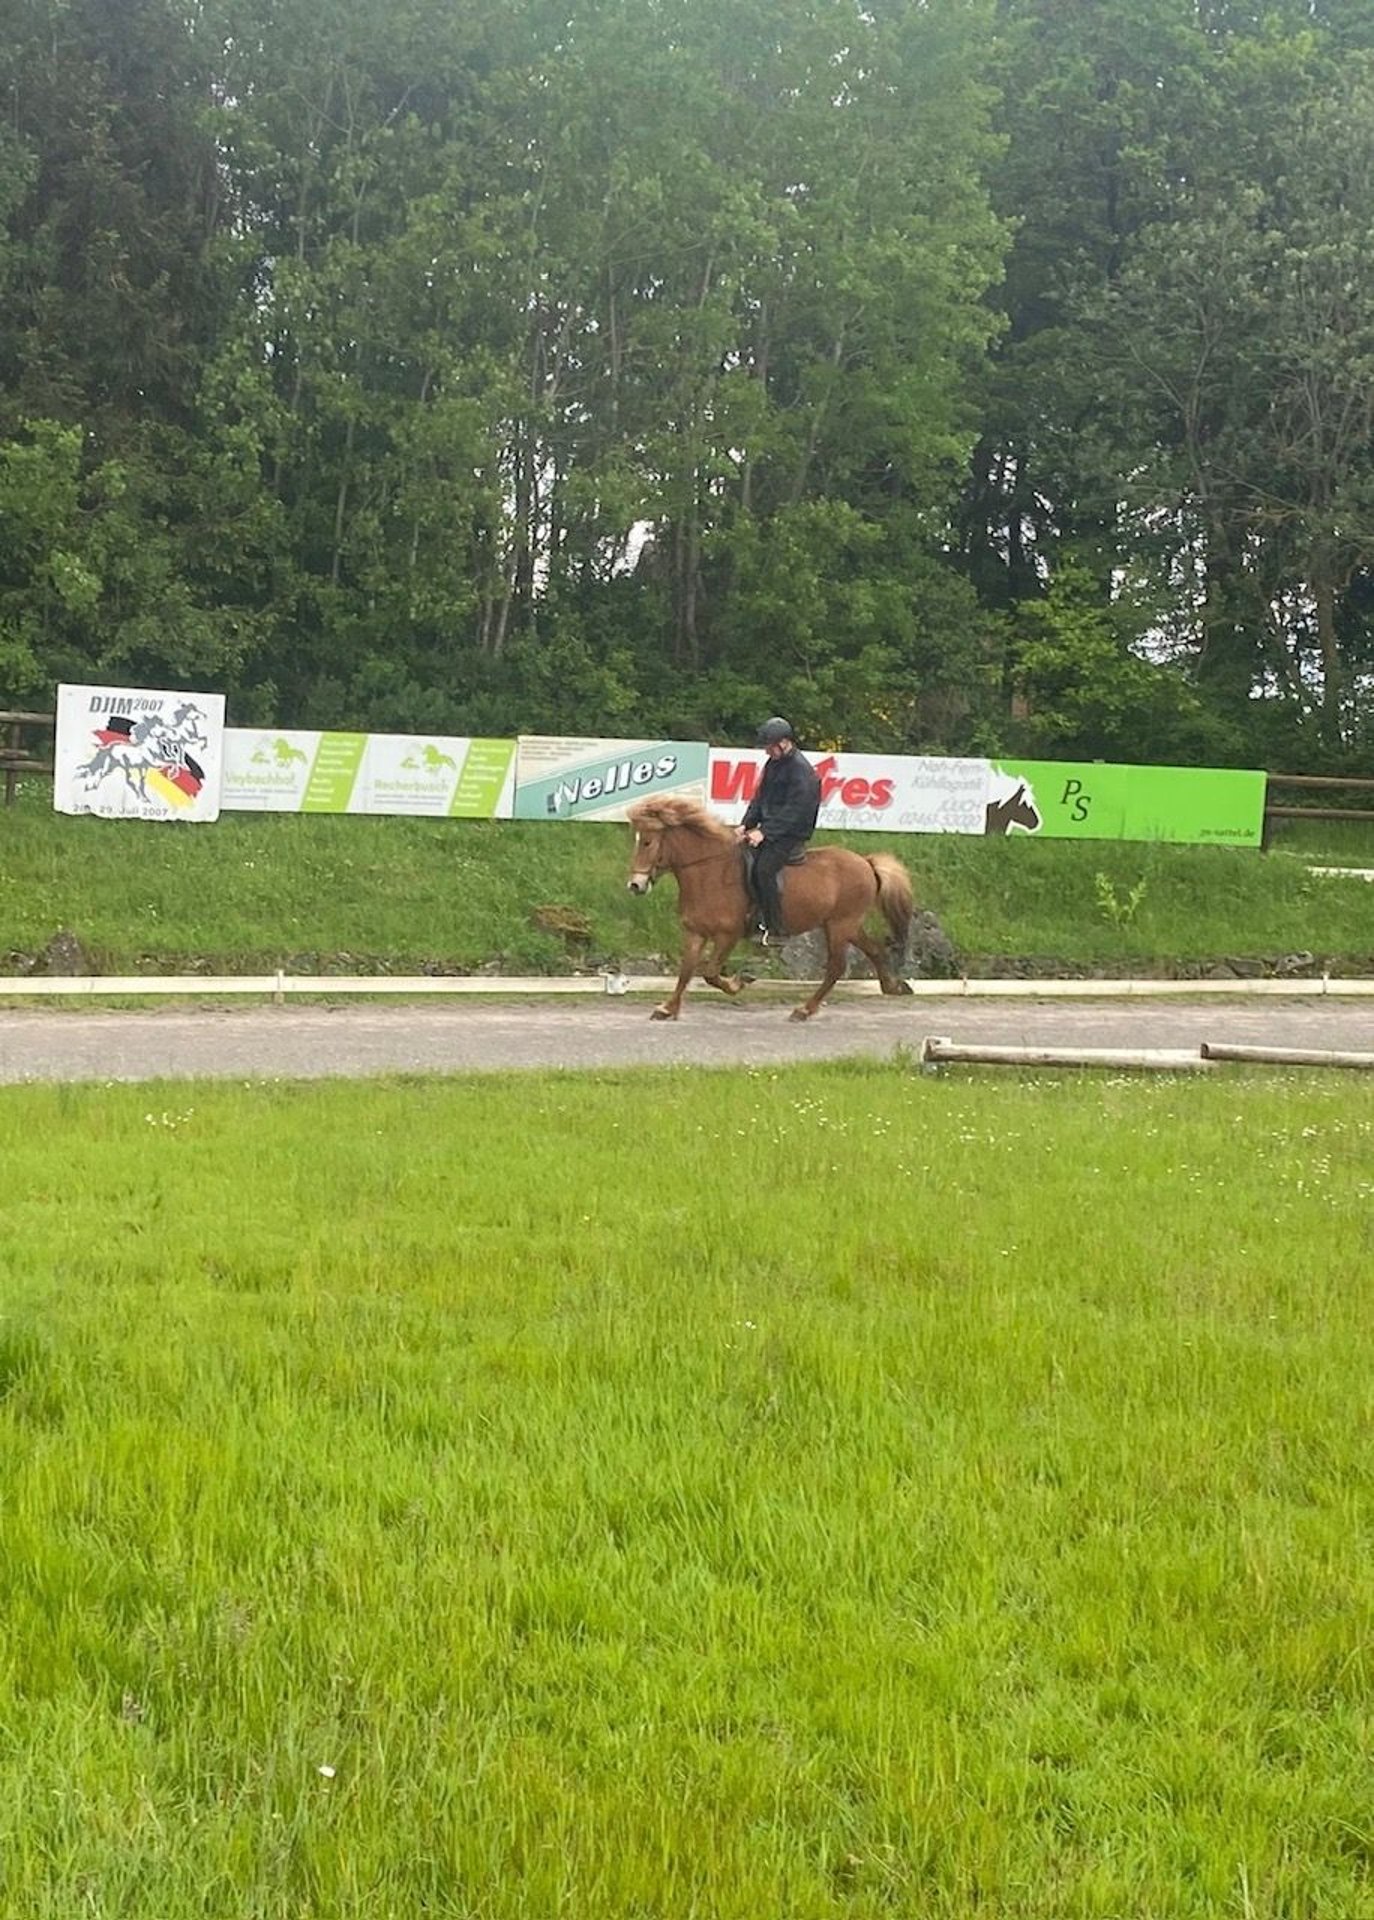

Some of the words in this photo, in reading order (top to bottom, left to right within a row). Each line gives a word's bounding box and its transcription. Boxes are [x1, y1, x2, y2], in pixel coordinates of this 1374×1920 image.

[89, 696, 133, 715] DJIM
[133, 698, 164, 712] 2007
[554, 754, 678, 811] Nelles
[119, 806, 139, 815] Juli
[142, 807, 169, 817] 2007
